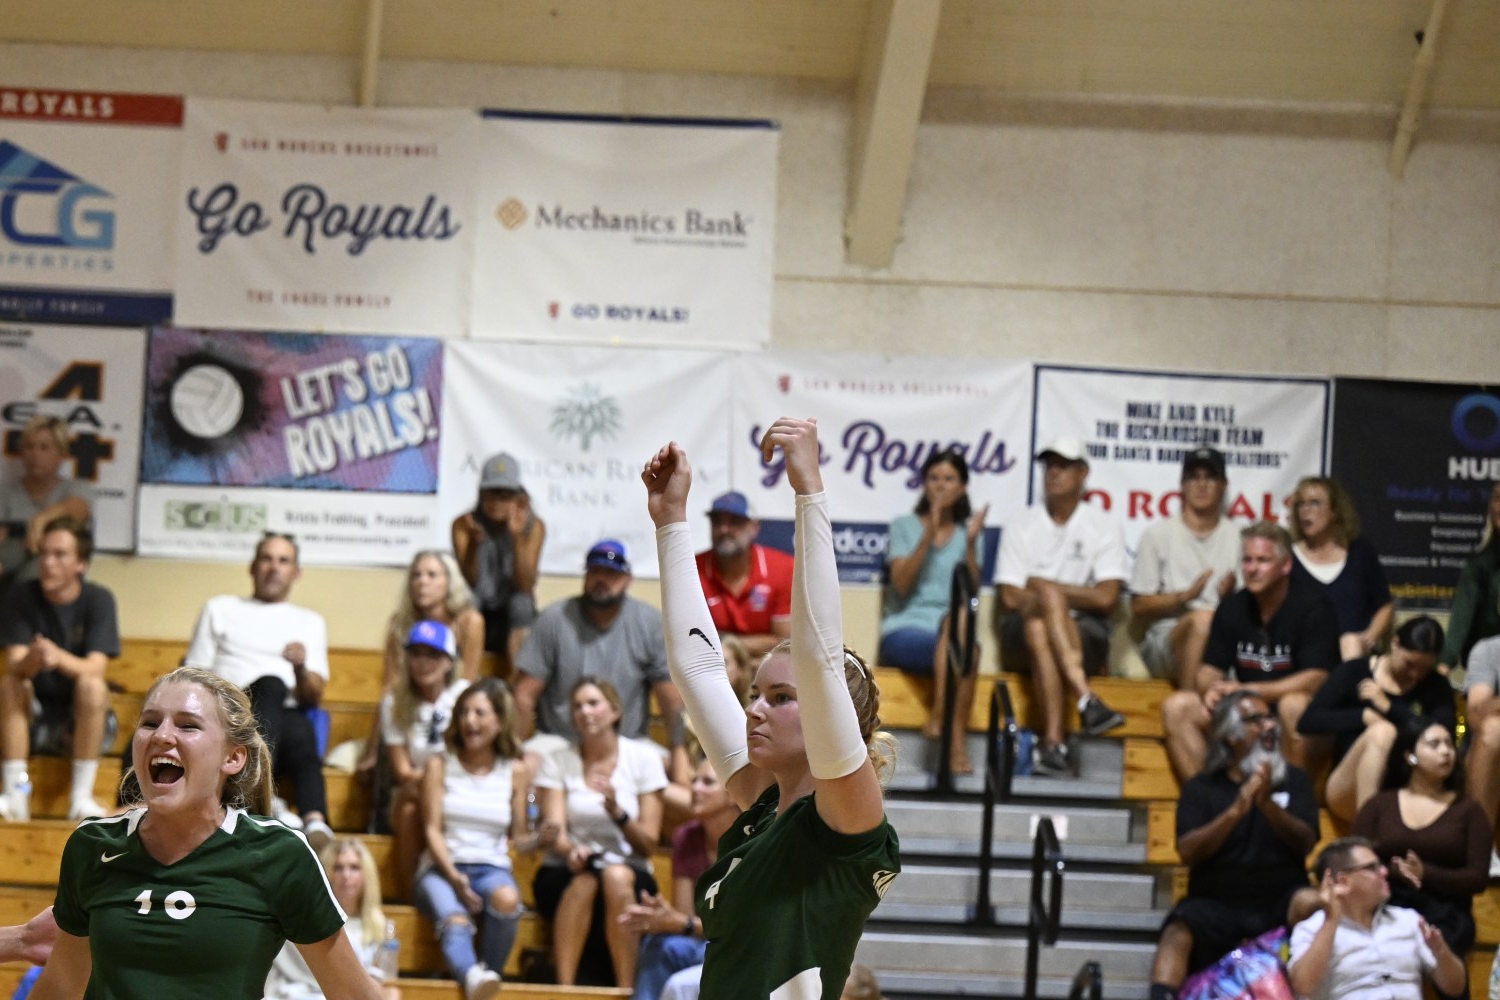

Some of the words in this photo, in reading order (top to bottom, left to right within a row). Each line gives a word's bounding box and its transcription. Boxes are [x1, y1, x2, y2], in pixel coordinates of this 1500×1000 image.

[0, 92, 114, 117] ROYALS
[187, 183, 270, 254] Go
[281, 183, 461, 256] Royals
[535, 204, 676, 233] Mechanics
[684, 208, 747, 237] Bank
[571, 304, 601, 319] GO
[281, 357, 367, 419] LET'S
[366, 344, 411, 396] GO
[1167, 404, 1196, 421] AND
[283, 386, 438, 478] ROYALS!
[1096, 421, 1119, 438] THE
